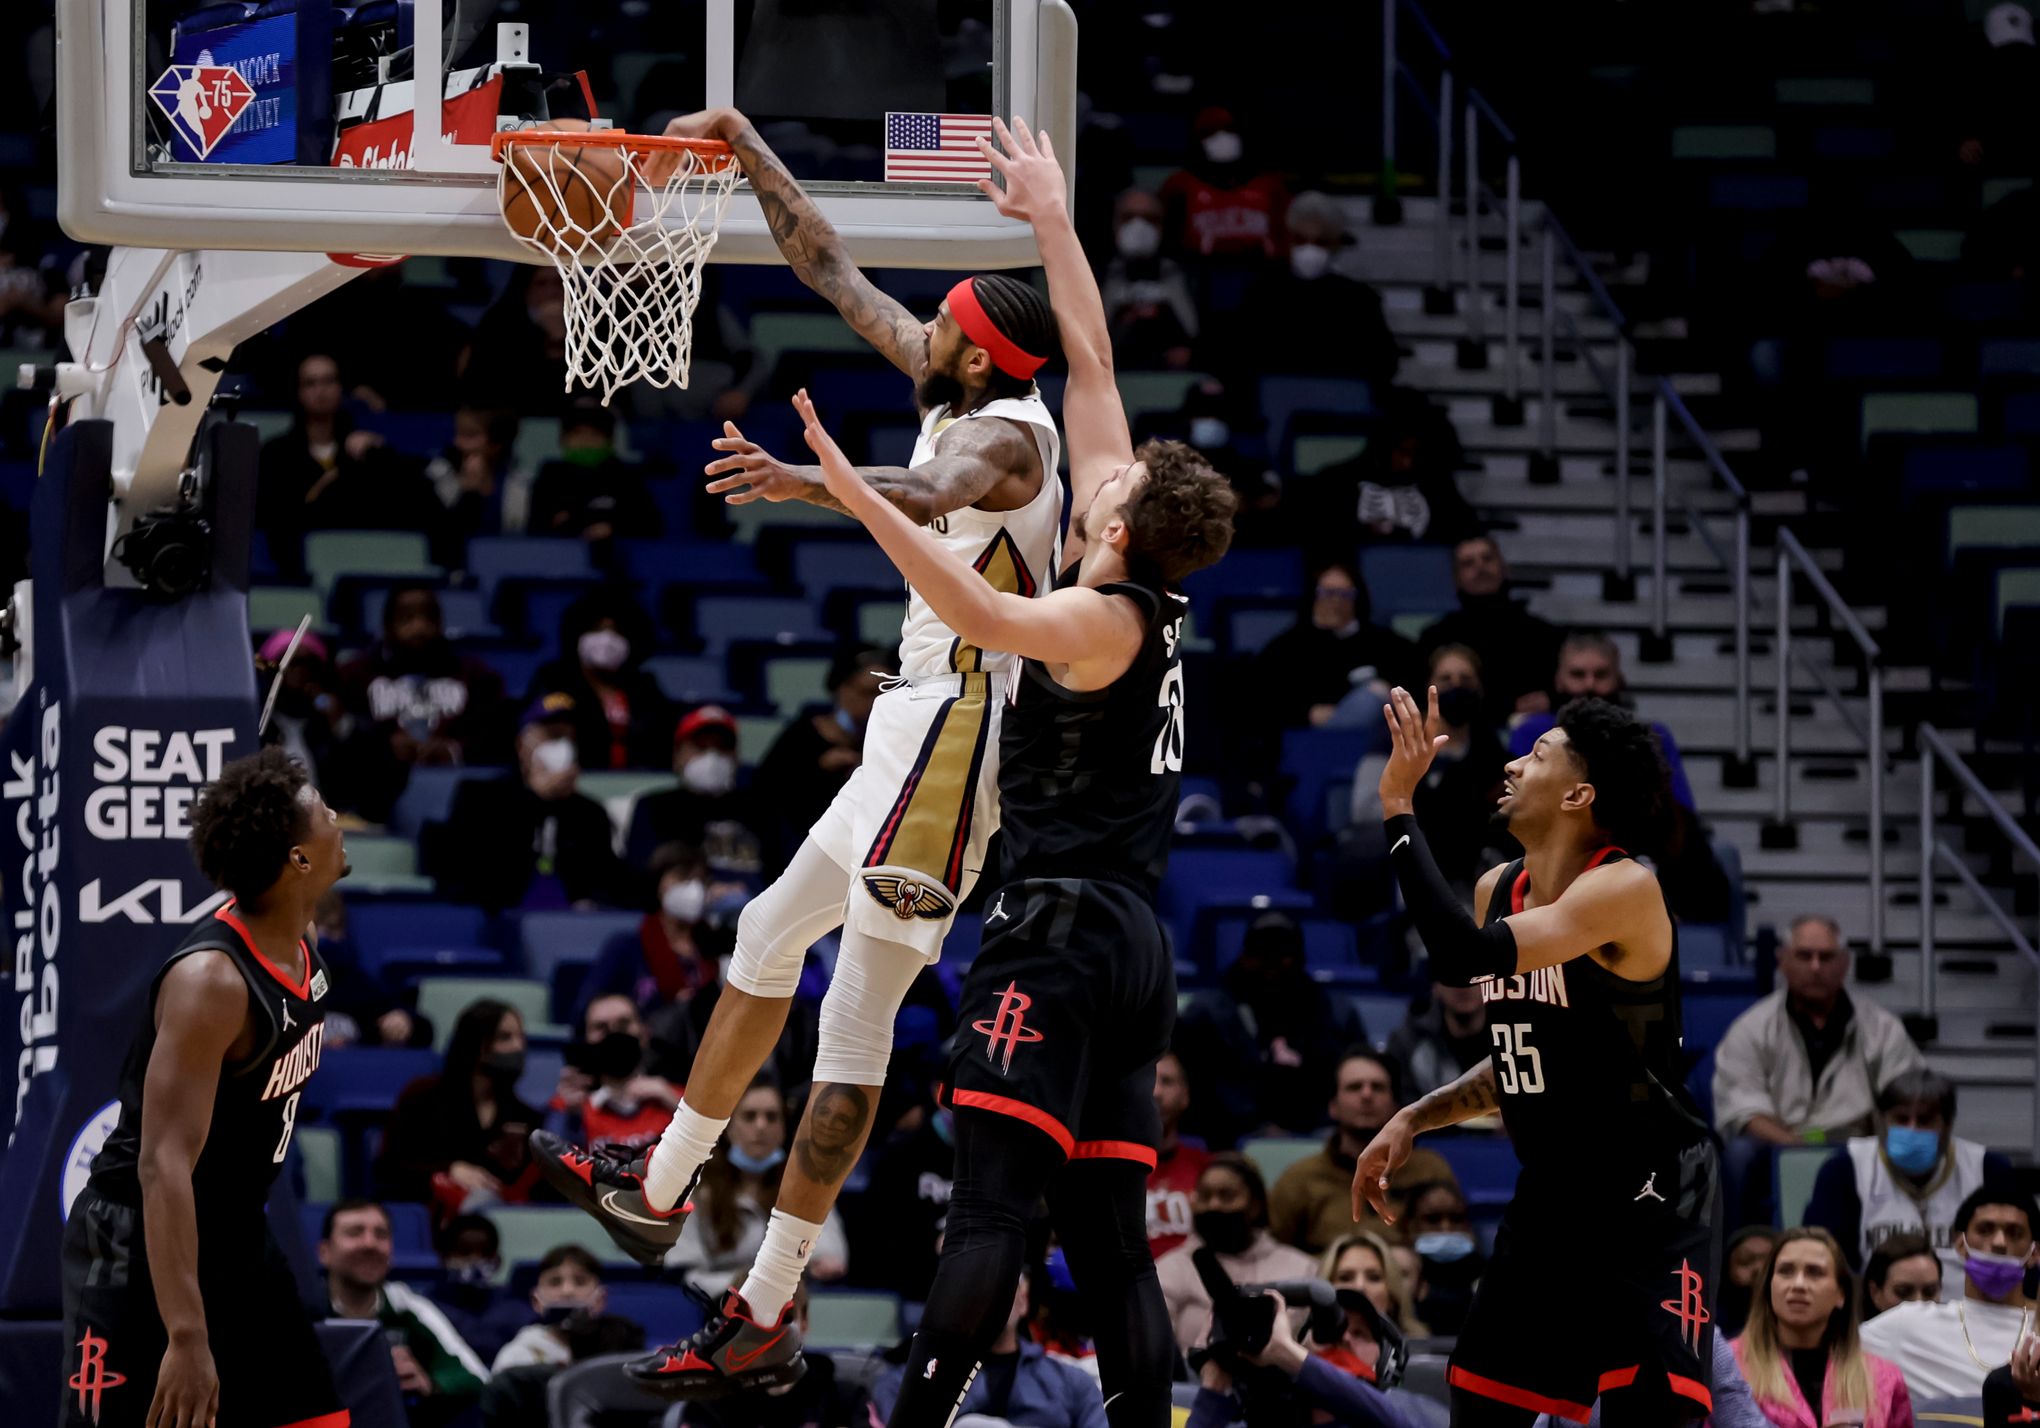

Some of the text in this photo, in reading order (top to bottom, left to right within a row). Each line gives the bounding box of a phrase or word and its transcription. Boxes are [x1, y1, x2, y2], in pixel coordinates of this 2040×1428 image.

[211, 79, 232, 108] 75
[93, 725, 236, 783] SEAT
[84, 785, 206, 840] GEE
[1491, 1023, 1545, 1094] 35
[272, 1091, 301, 1164] 8
